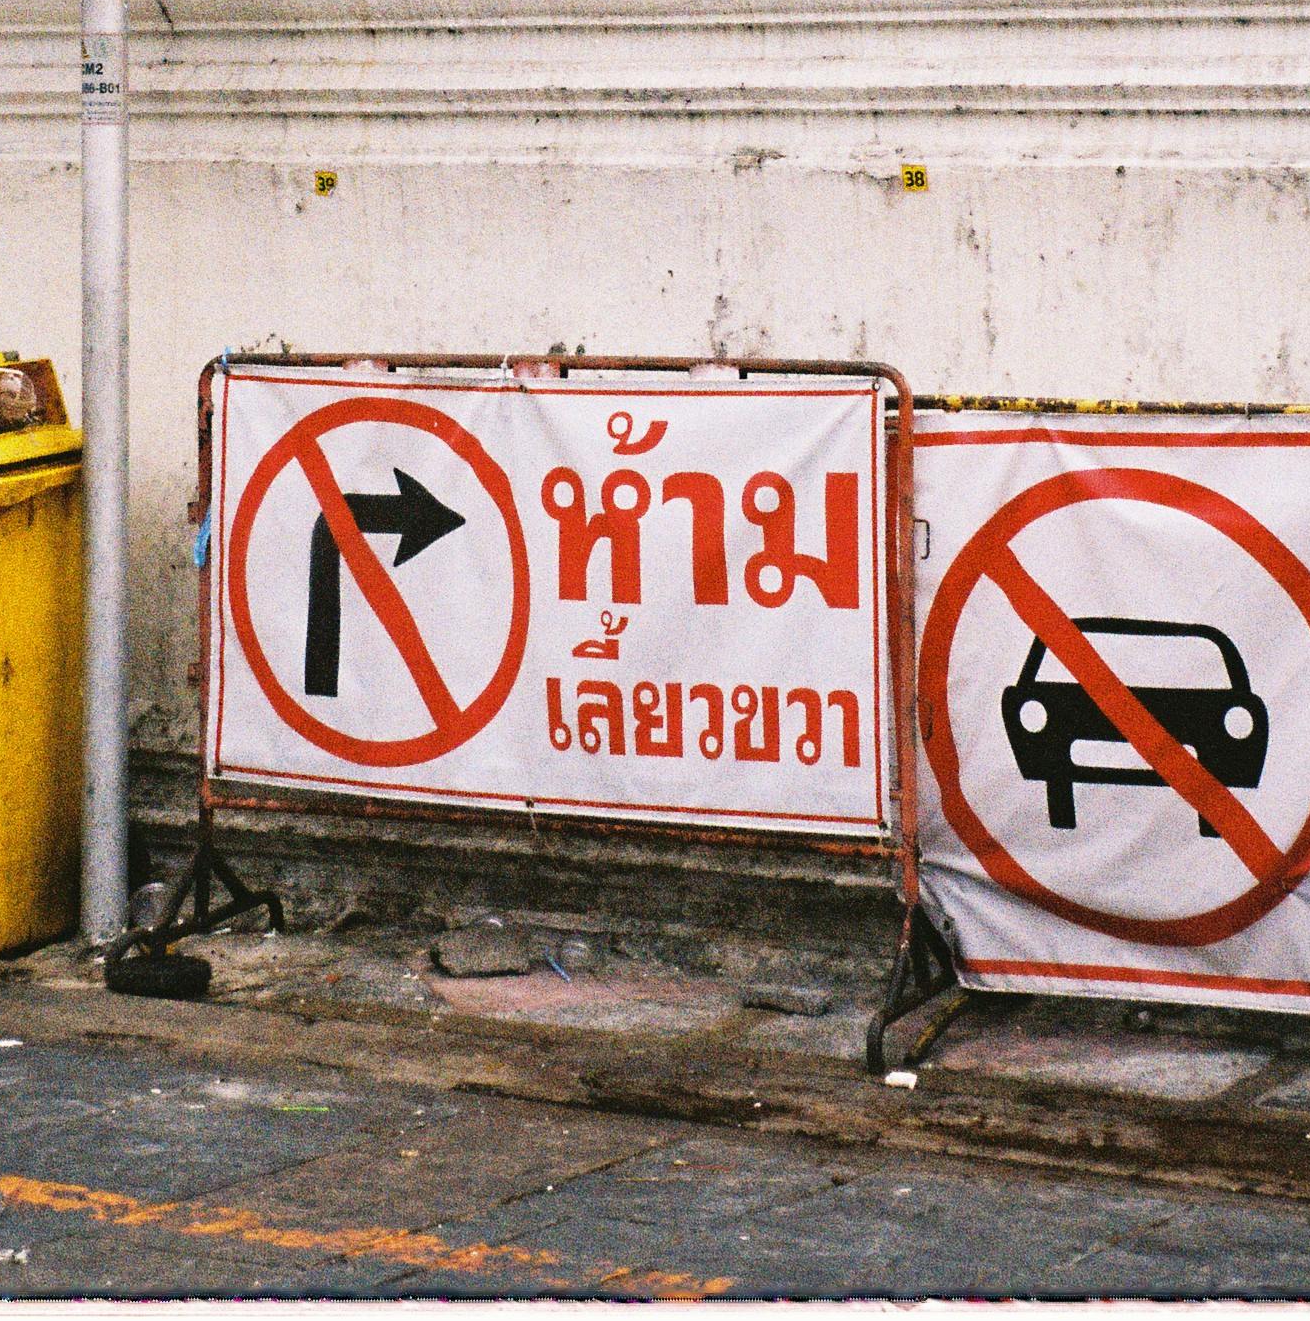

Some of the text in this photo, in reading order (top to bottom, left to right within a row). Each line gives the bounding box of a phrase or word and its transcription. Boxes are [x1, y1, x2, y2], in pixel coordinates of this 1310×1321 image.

[905, 170, 925, 187] 38
[540, 410, 860, 610] ห้าม
[545, 609, 861, 768] เลี้ยวขวา
